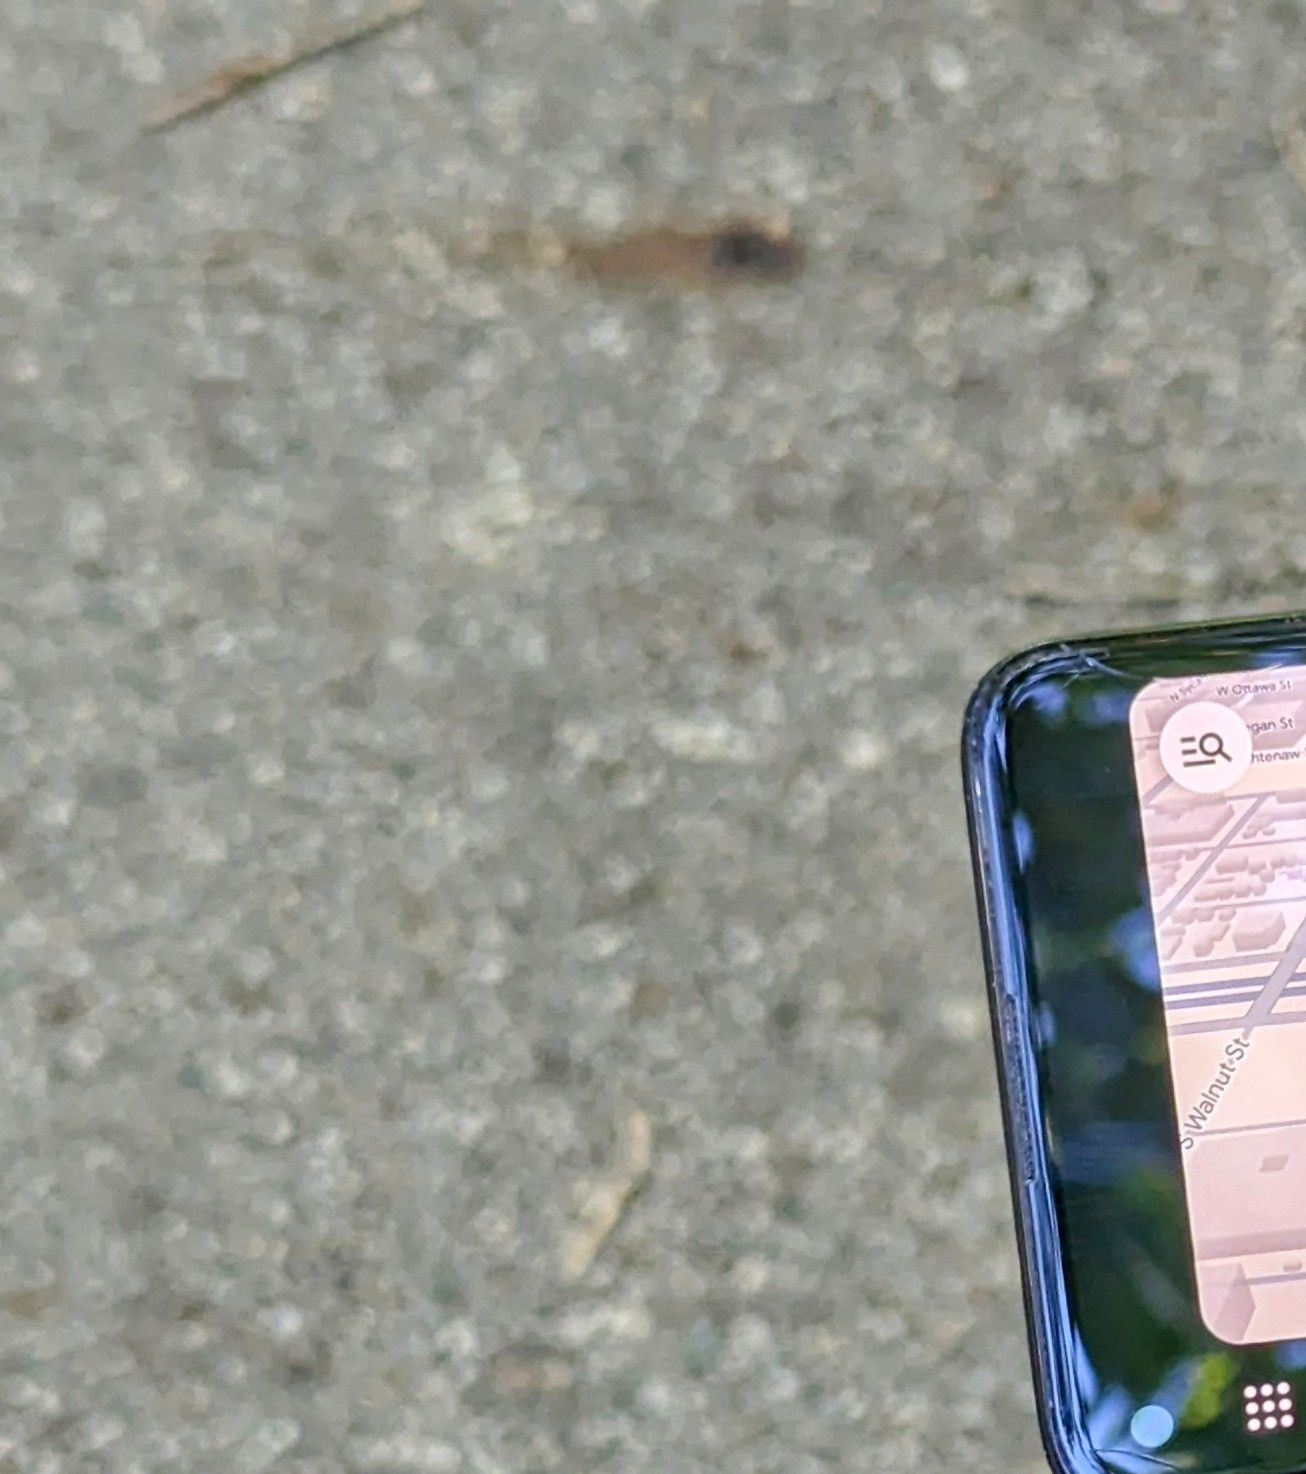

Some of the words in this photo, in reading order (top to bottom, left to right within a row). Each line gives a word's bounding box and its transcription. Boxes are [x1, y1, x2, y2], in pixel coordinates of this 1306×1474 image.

[1279, 680, 1291, 691] St
[1280, 717, 1293, 729] St
[1185, 1061, 1236, 1130] Walnut
[1225, 1037, 1250, 1061] St
